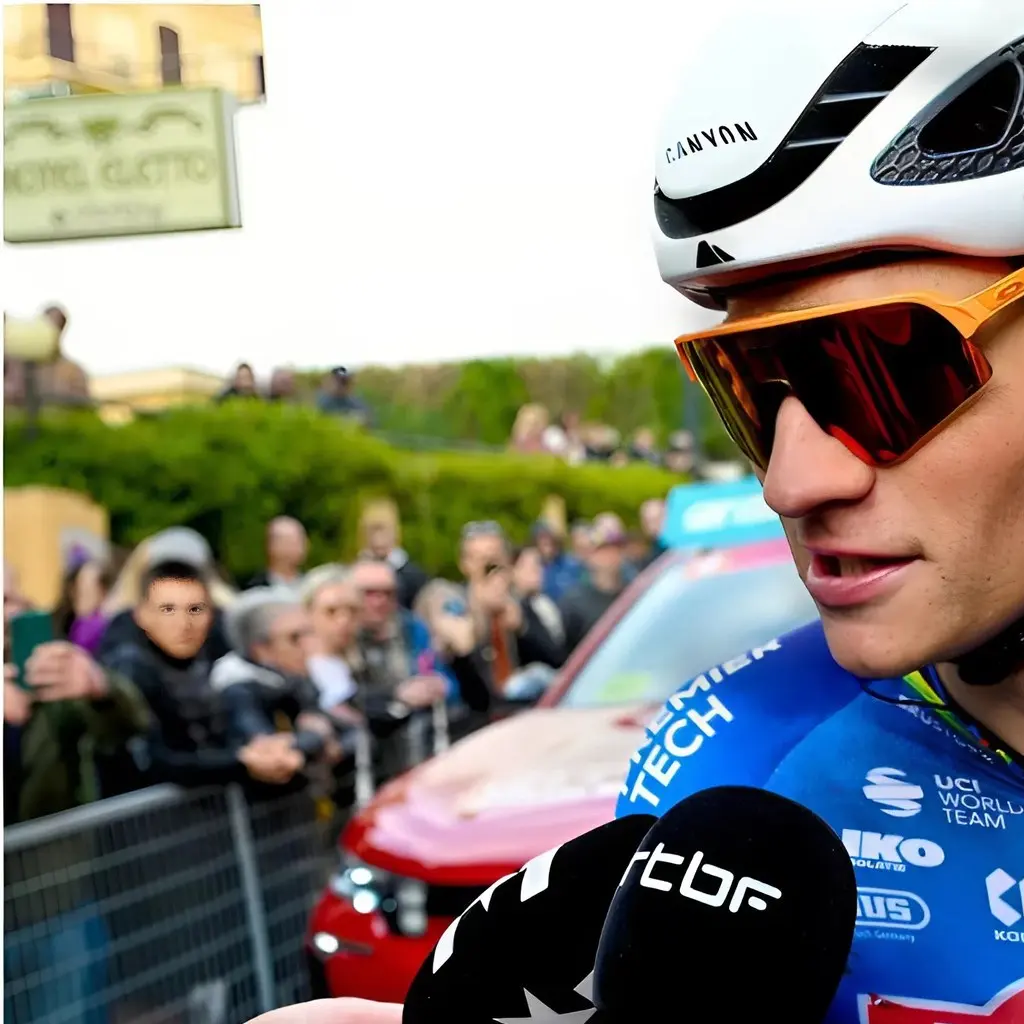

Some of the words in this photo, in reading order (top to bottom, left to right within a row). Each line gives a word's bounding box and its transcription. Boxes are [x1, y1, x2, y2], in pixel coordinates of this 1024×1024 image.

[666, 121, 758, 164] CANYON
[629, 694, 734, 807] TECH
[934, 773, 982, 794] UCI
[938, 790, 1024, 815] WORLD
[942, 807, 1007, 830] TEAM
